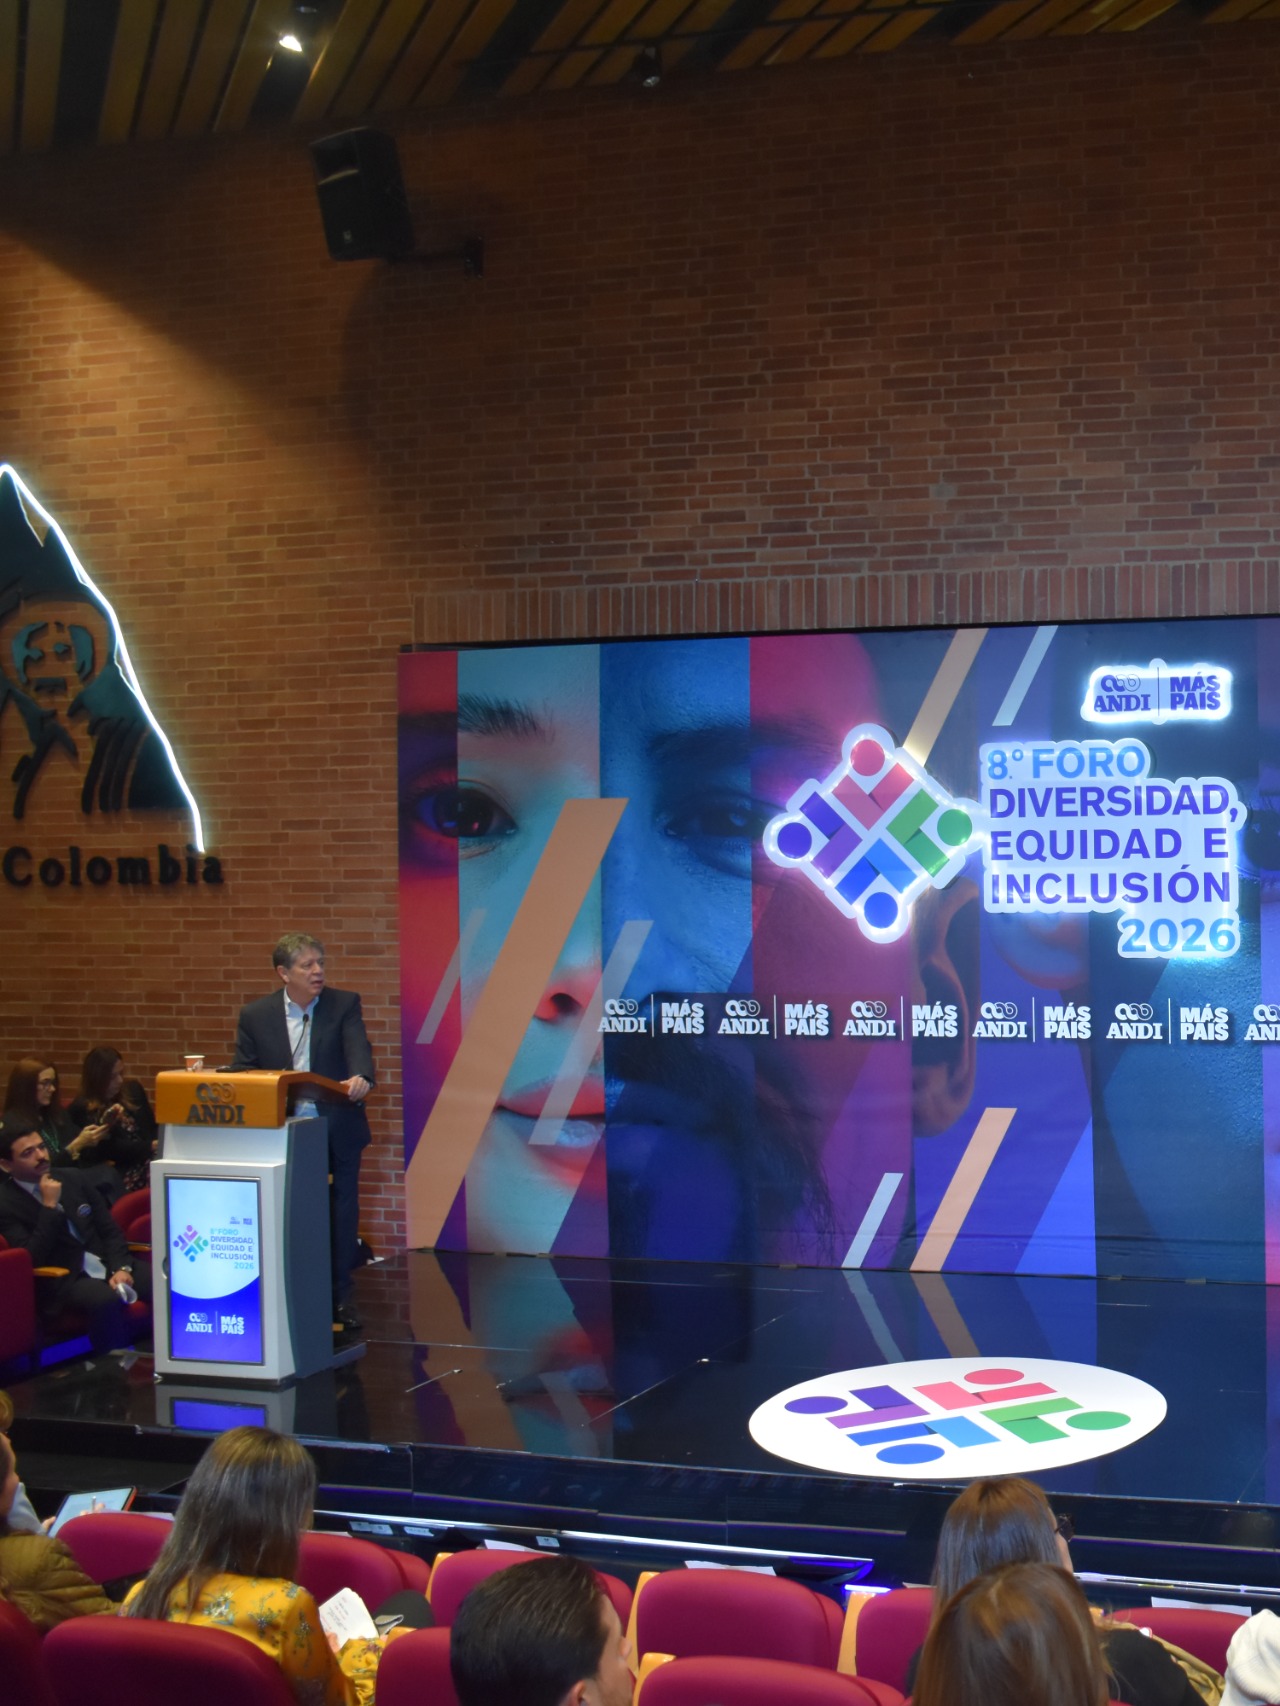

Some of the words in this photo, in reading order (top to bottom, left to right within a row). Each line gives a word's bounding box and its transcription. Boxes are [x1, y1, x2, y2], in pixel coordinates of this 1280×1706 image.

[1170, 671, 1221, 692] MÁS
[1094, 694, 1151, 713] ANDI
[1032, 745, 1146, 779] FORO
[989, 784, 1239, 823] DIVERSIDAD,
[990, 828, 1182, 862] EQUIDAD
[1203, 827, 1229, 859] E
[3, 844, 224, 887] Colombia
[991, 864, 1231, 904] INCLUSIÓN
[1121, 918, 1237, 953] 2026
[661, 999, 705, 1018] MÁS
[784, 1000, 829, 1019] MÁS
[912, 1001, 958, 1020] MÁS
[1044, 1002, 1091, 1021] MÁS
[1180, 1003, 1229, 1023] MÁS
[597, 1017, 647, 1033] ANDI
[718, 1018, 770, 1035] ANDI
[842, 1020, 896, 1037] ANDI
[972, 1021, 1027, 1038] ANDI
[1106, 1023, 1163, 1039] ANDI
[187, 1104, 245, 1125] ANDI
[210, 1244, 245, 1252] EQUIDAD
[185, 1322, 213, 1333] ANDI
[221, 1314, 244, 1325] MÁS
